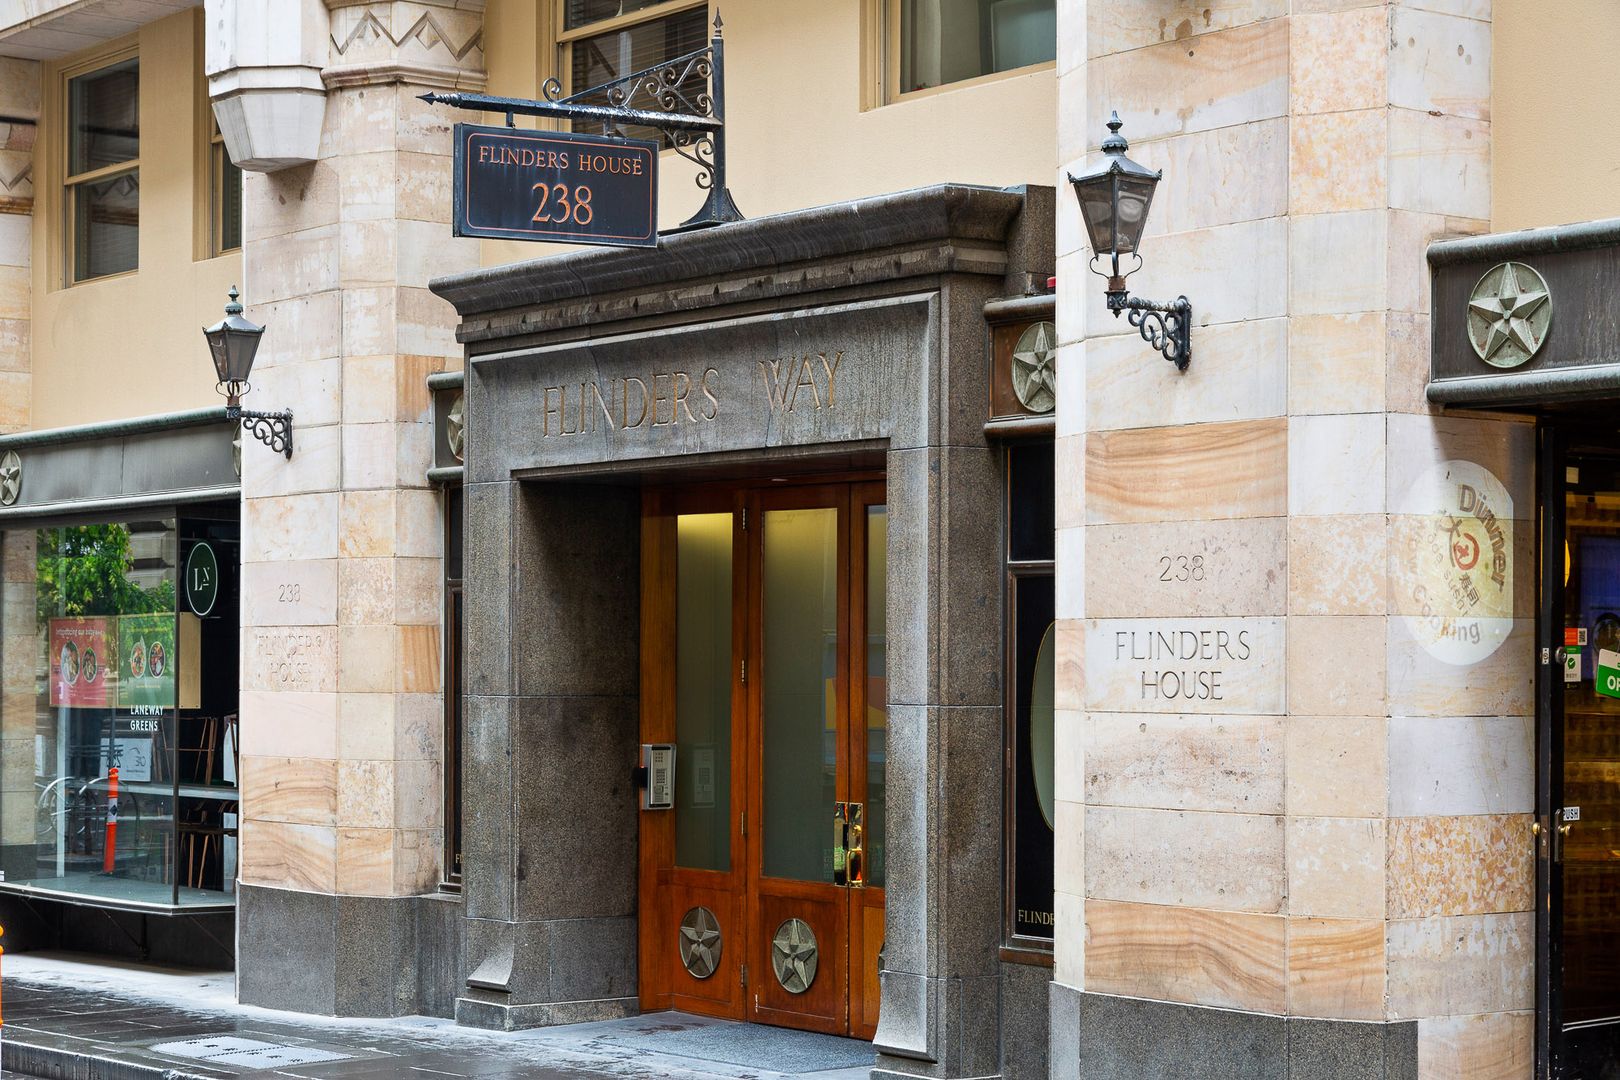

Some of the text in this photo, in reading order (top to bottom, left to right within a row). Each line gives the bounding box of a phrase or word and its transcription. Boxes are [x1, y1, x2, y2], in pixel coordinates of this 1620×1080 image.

[479, 145, 643, 176] FLINDERS HOUSE
[532, 182, 593, 226] 238
[543, 350, 845, 438] FLINDERS WAY
[1159, 555, 1205, 582] 238
[278, 584, 301, 602] 238
[1115, 630, 1251, 661] FLINDERS
[1141, 670, 1223, 700] HOUSE
[130, 704, 164, 716] LANEWAY
[130, 720, 159, 732] GREENS
